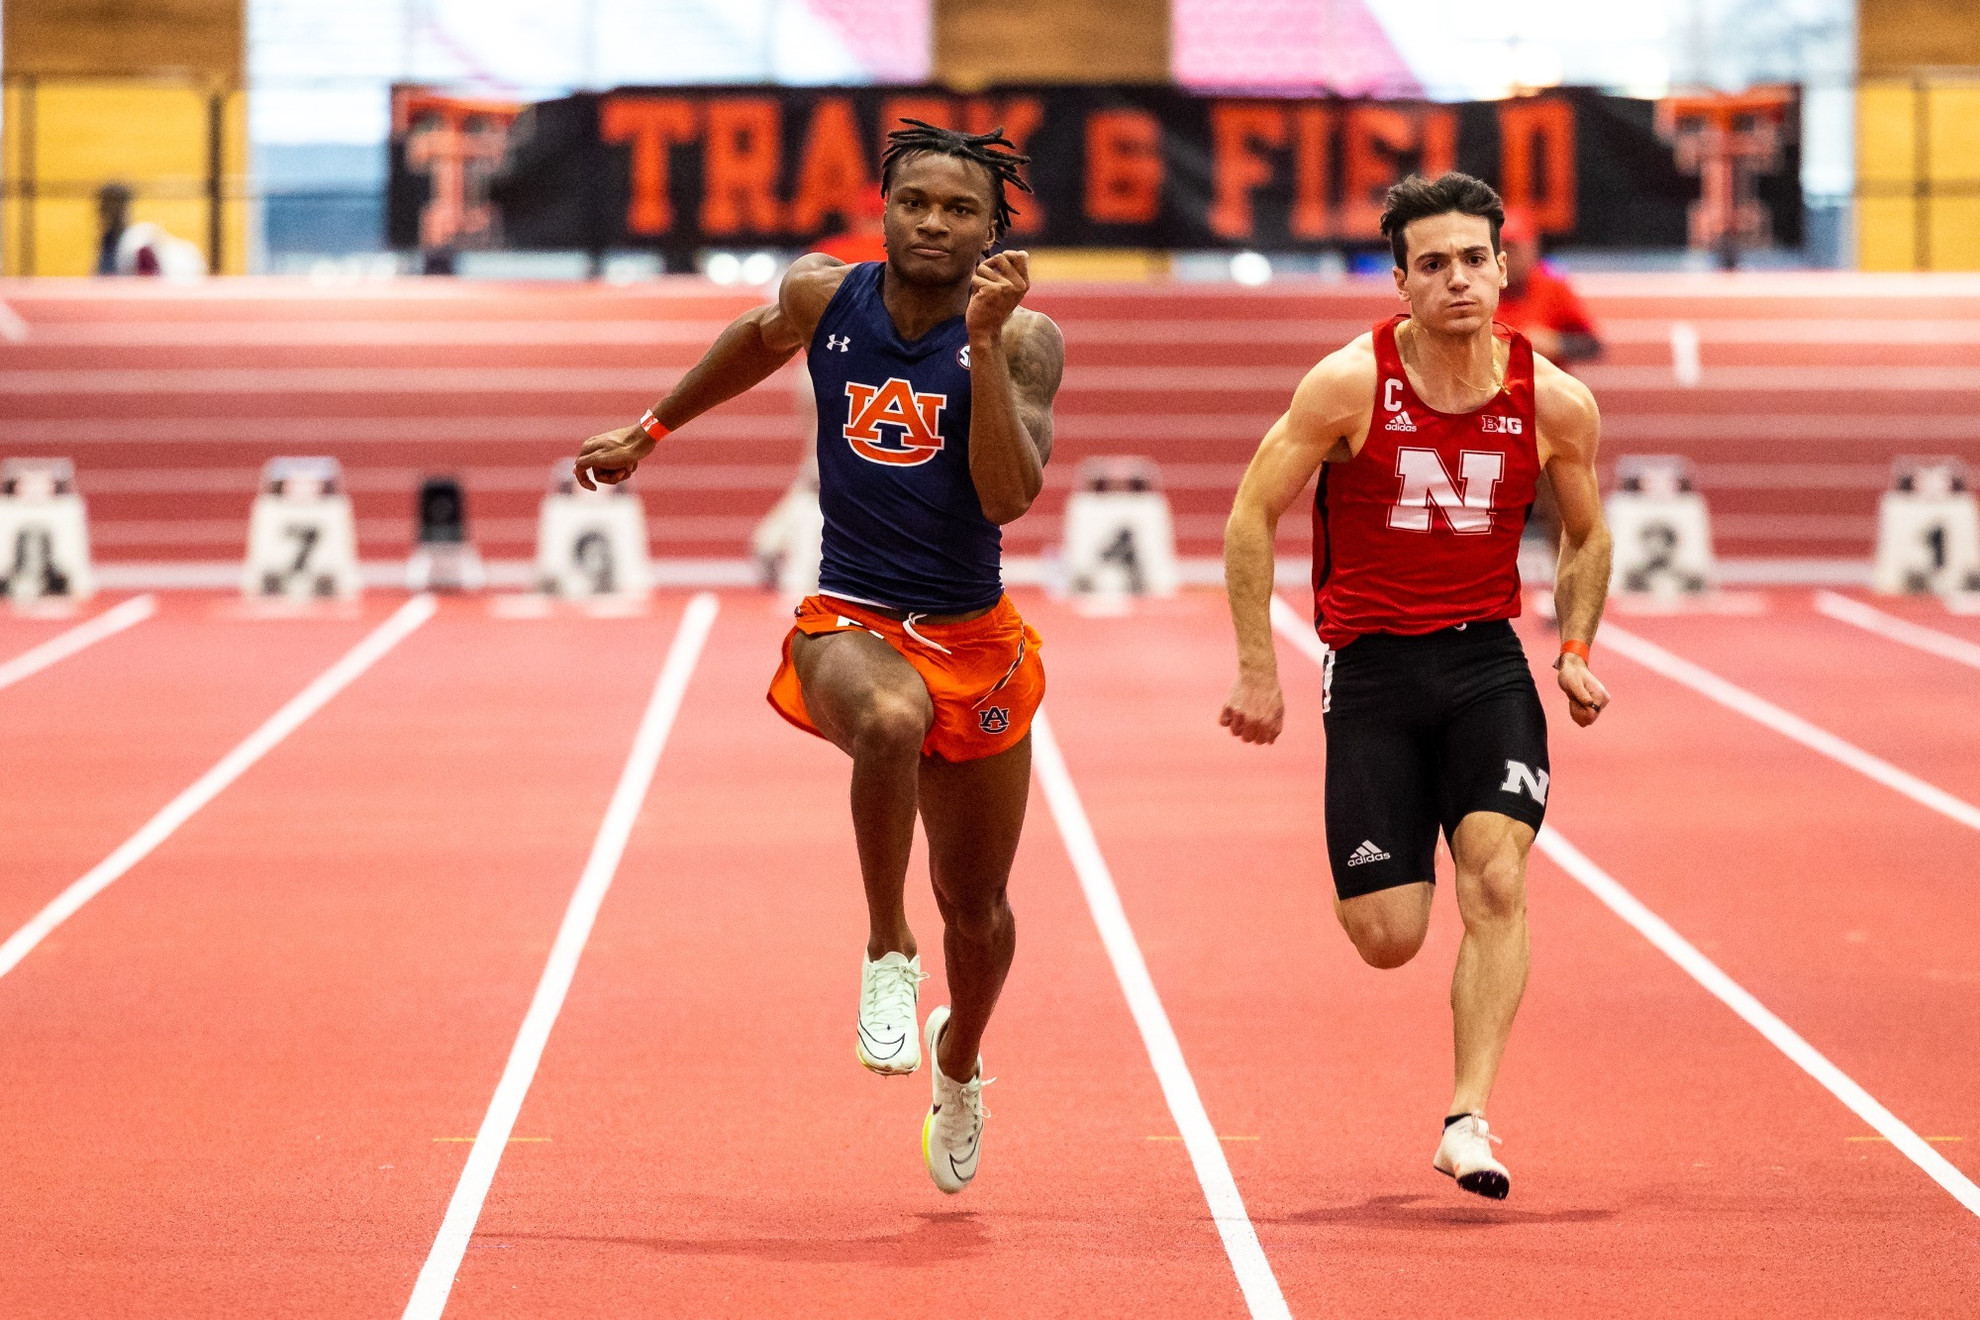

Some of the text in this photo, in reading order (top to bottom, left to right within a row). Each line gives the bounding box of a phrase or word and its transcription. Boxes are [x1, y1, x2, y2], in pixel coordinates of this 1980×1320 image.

[1384, 378, 1403, 412] C
[1385, 423, 1417, 433] adidas
[1386, 446, 1505, 535] N
[284, 524, 319, 575] 7
[1501, 759, 1549, 807] N
[1347, 851, 1391, 867] adidas
